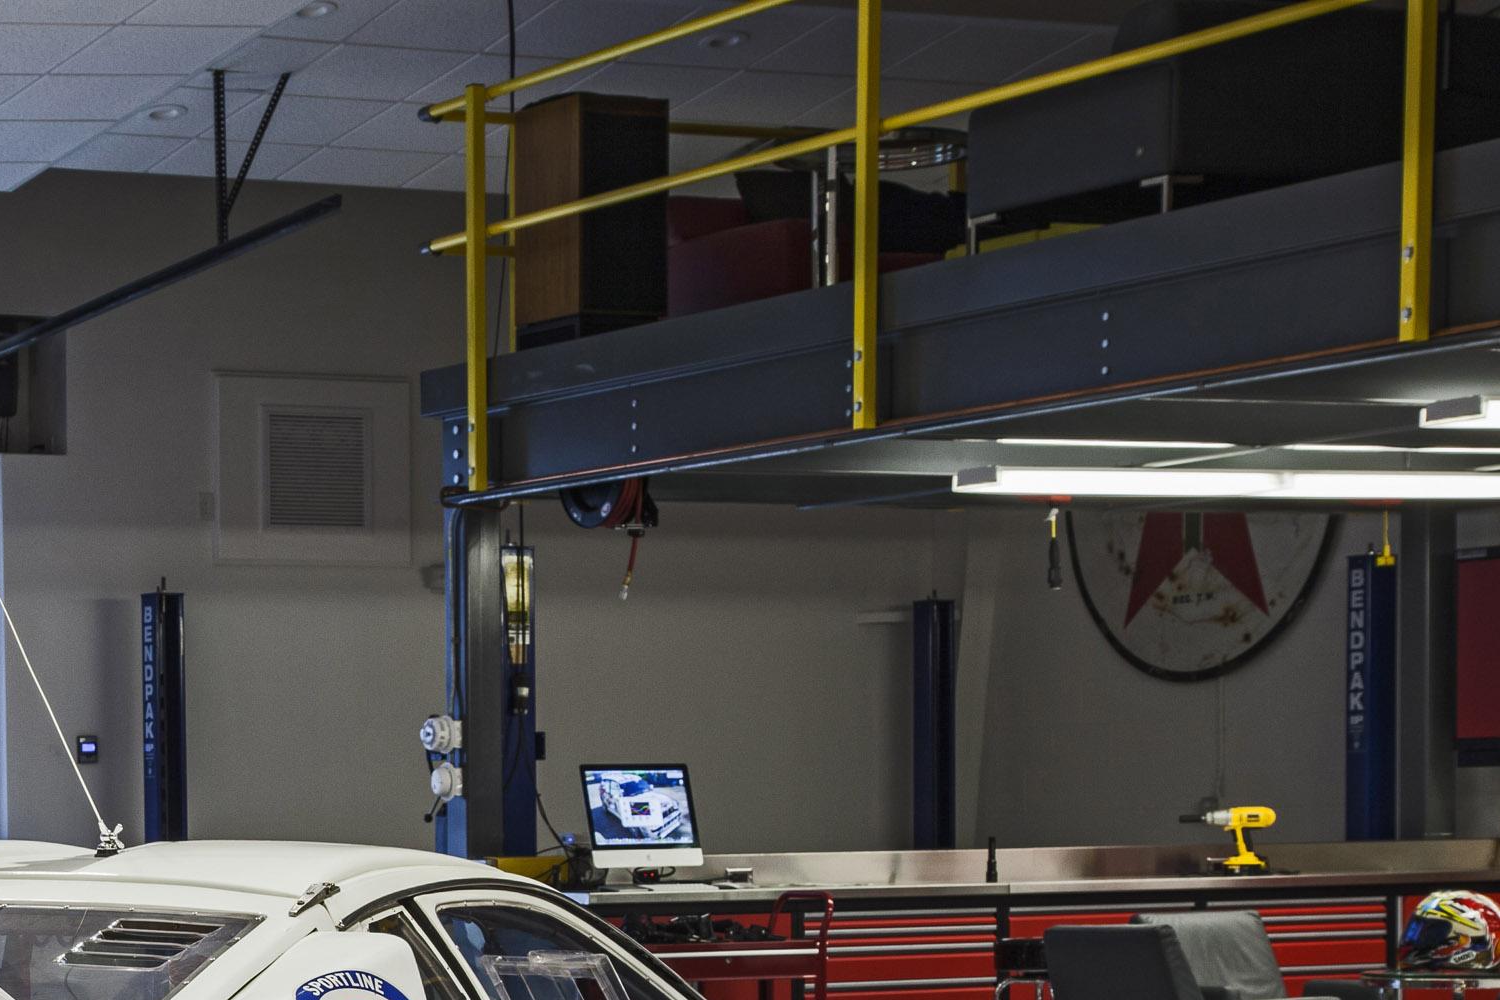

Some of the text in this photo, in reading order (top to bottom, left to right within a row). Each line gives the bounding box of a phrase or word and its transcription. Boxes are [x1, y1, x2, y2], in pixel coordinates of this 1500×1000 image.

[143, 606, 154, 739] BENDPAK
[1350, 569, 1365, 710] BENDPAK
[303, 972, 385, 996] SPORTLINE
